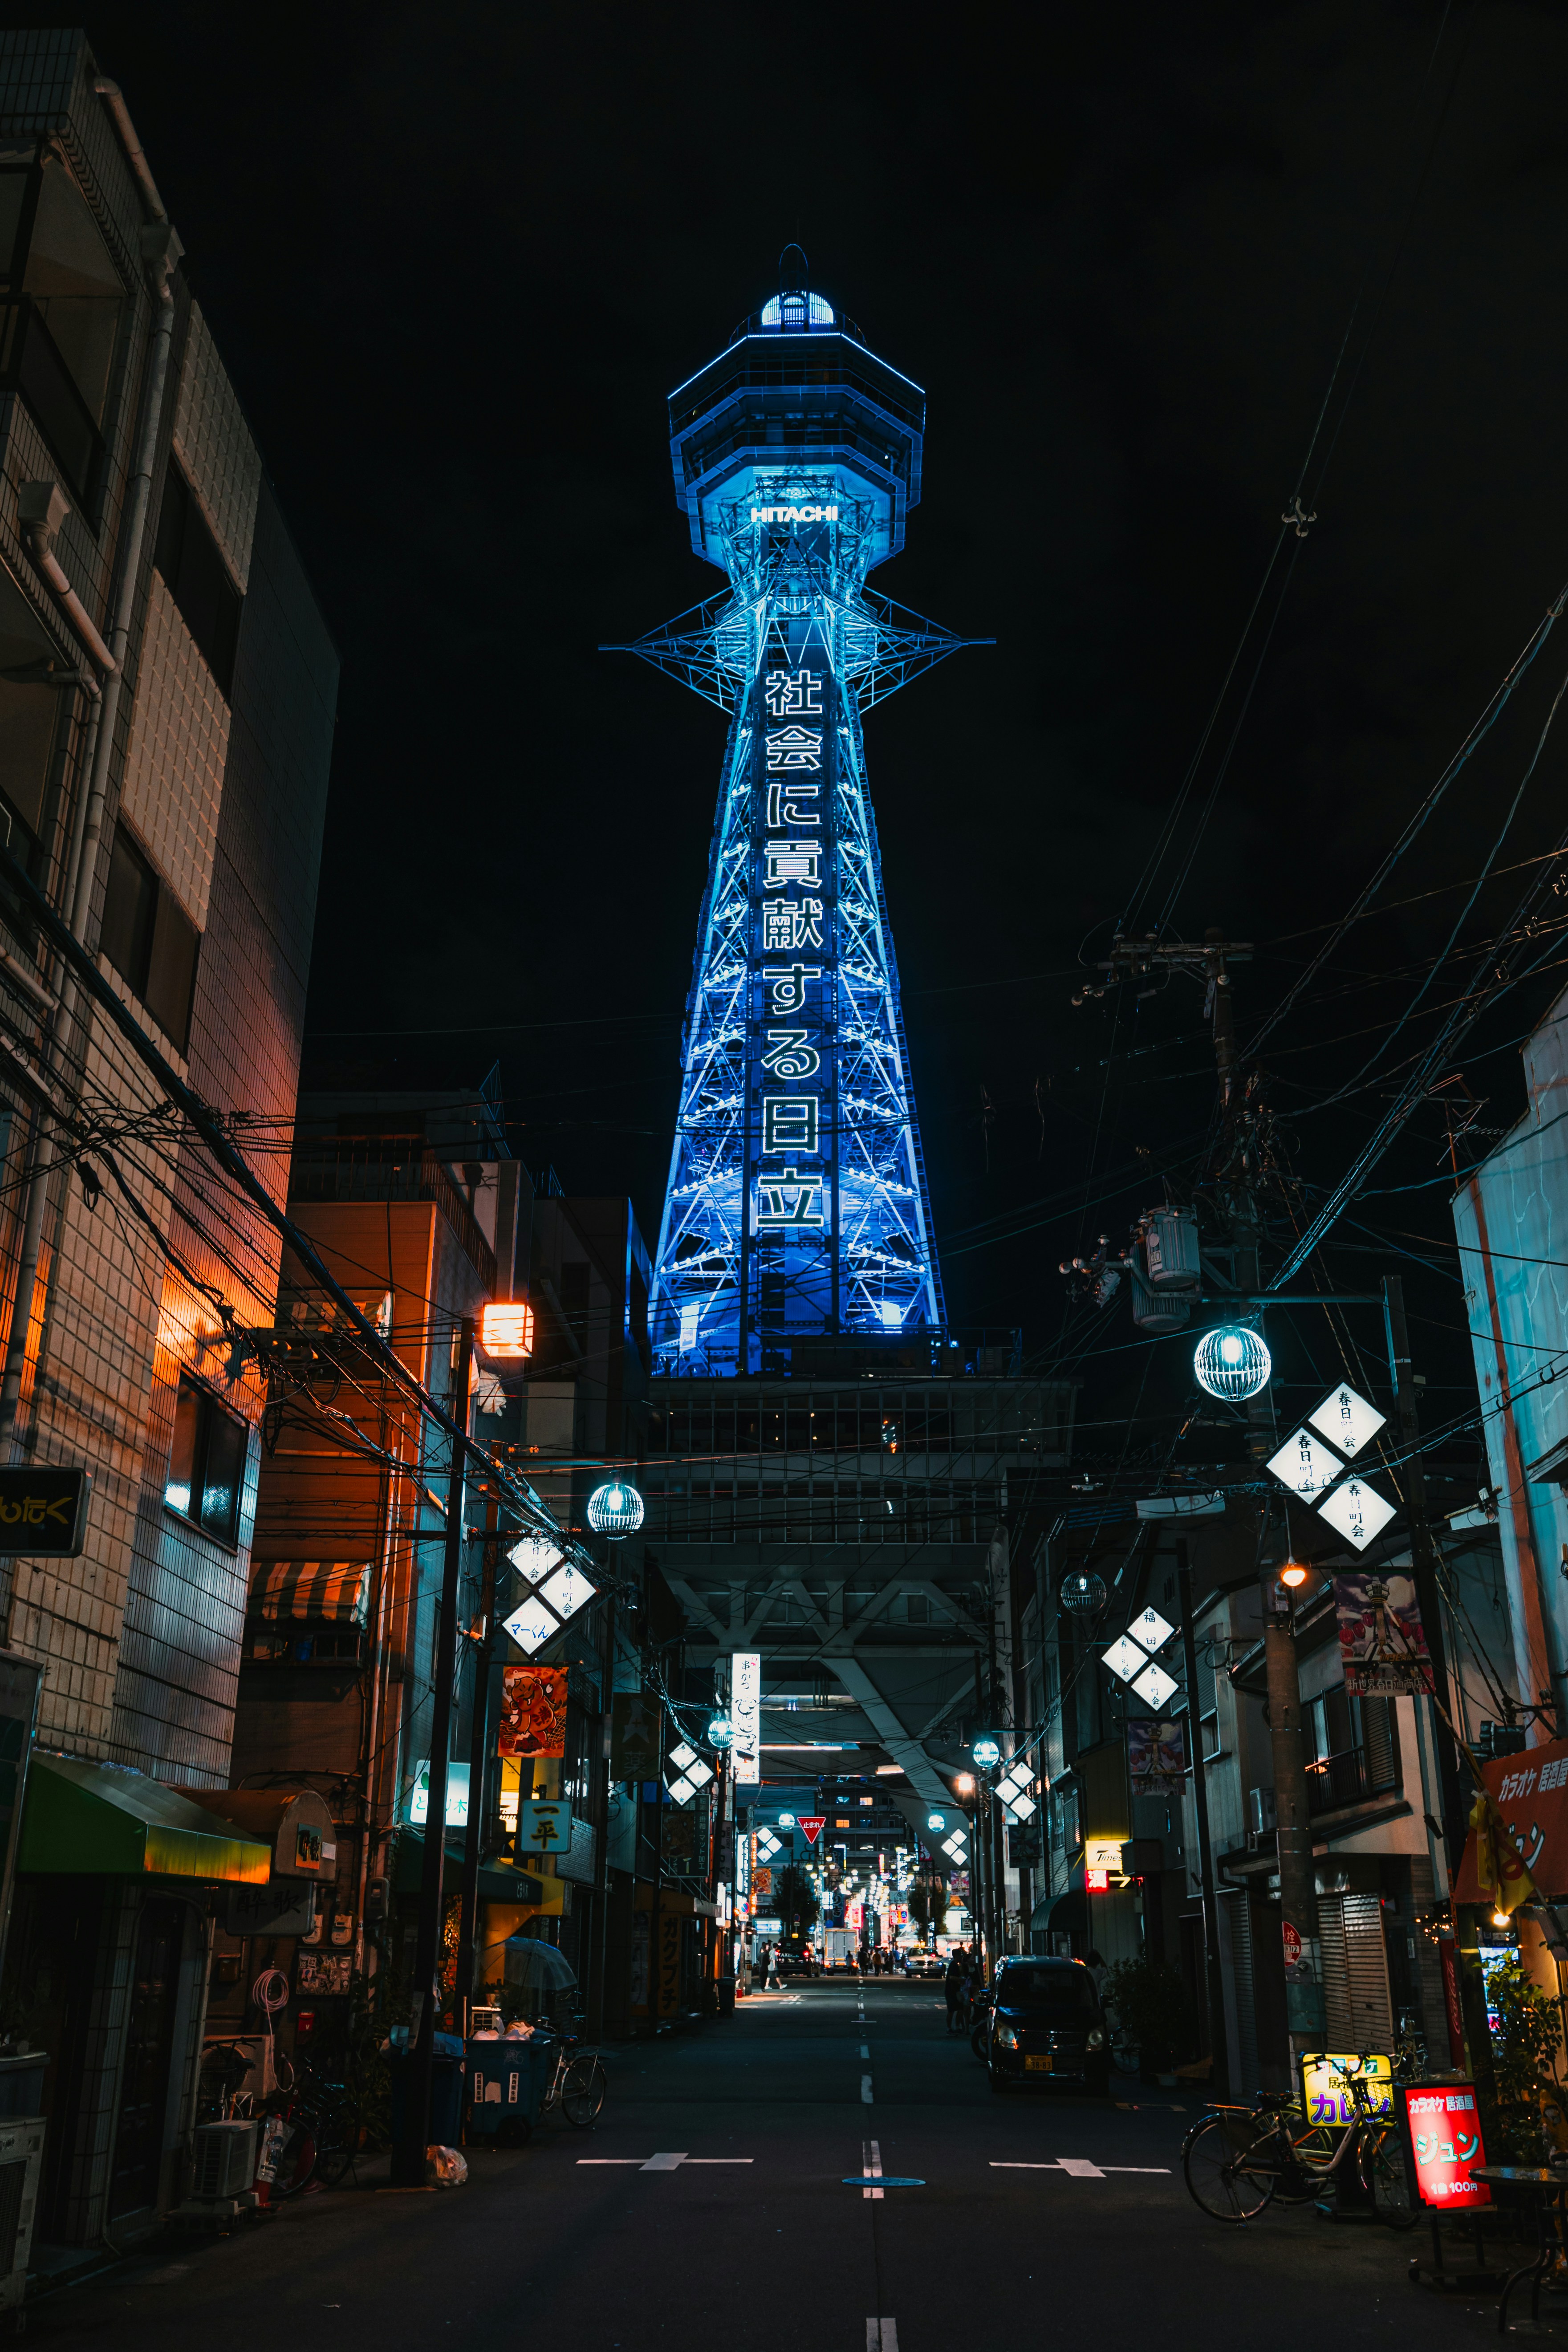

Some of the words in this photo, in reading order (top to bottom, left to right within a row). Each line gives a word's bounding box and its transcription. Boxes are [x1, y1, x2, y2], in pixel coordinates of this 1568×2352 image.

[751, 506, 838, 522] HITACHI
[756, 669, 824, 1228] 社会に貢献する日立
[511, 1623, 550, 1639] マーくん
[1143, 1611, 1156, 1645] 福田
[741, 1659, 751, 1690] 串かつ
[624, 1750, 647, 1774] 薬
[1498, 1768, 1537, 1802] カラオケ
[1538, 1757, 1568, 1793] 居酒屋
[531, 1806, 560, 1850] 一平
[1097, 1850, 1122, 1862] Times
[662, 1917, 678, 2011] ガクブチ
[1032, 2061, 1051, 2070] 38-83
[1409, 2096, 1445, 2114] カラオケ
[1446, 2095, 1475, 2111] 居酒屋
[1416, 2131, 1479, 2165] ジュン
[1449, 2181, 1478, 2194] 100円
